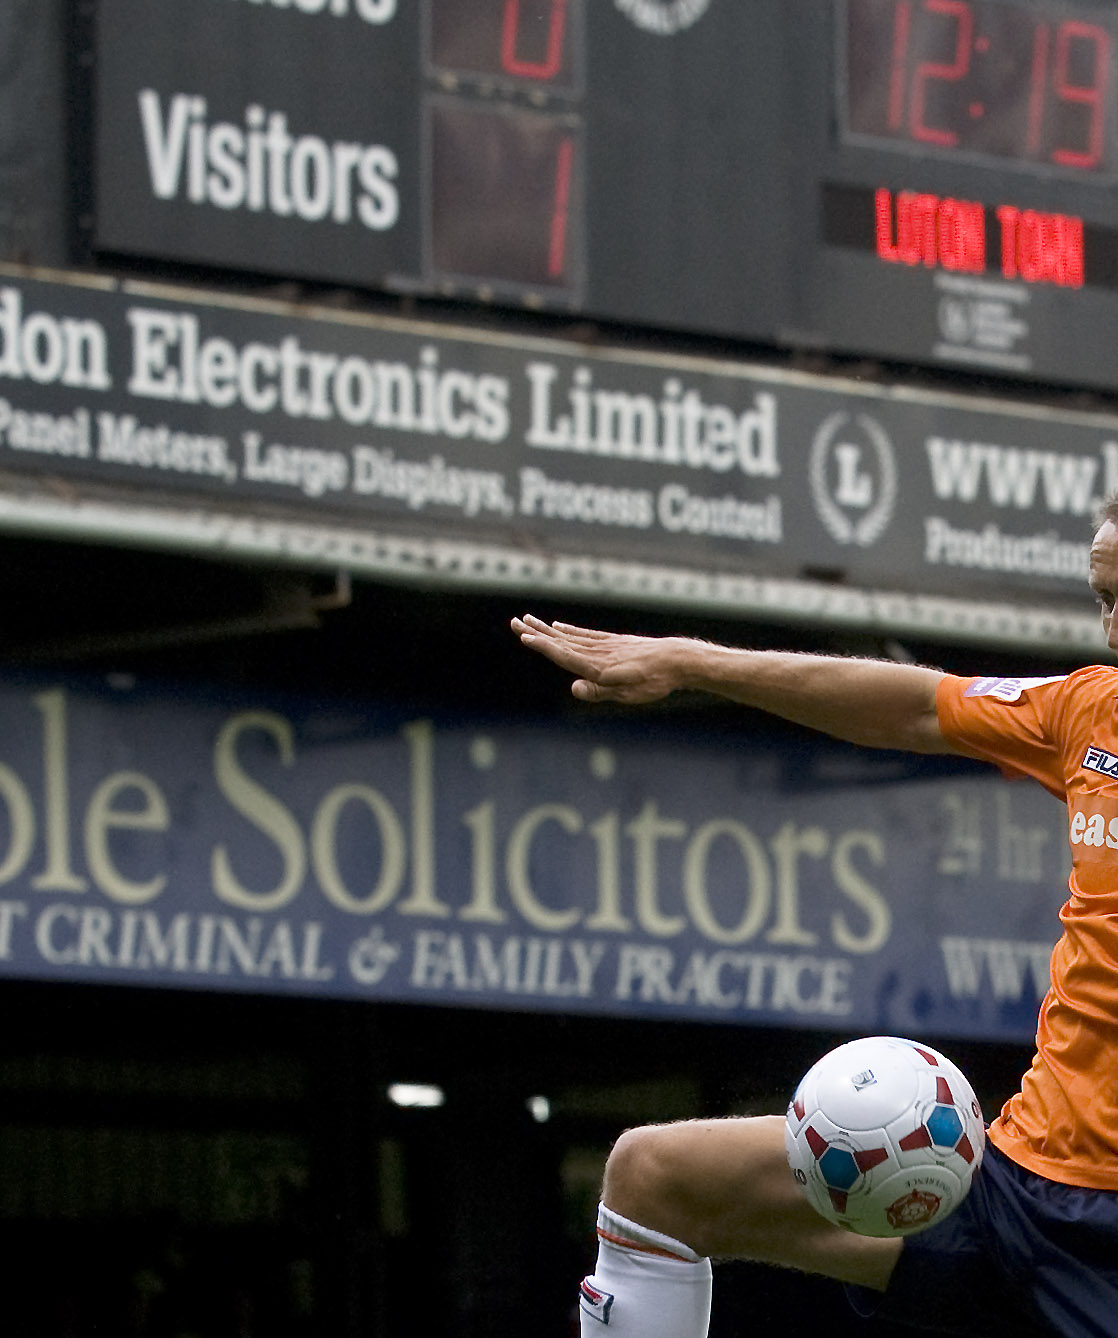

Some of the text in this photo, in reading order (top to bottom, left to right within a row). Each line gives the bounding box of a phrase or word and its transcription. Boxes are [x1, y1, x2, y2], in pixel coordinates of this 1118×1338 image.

[138, 88, 400, 232] Visitors
[126, 308, 510, 443] Electronics
[525, 360, 780, 478] Limited
[97, 411, 238, 484] Meters,
[241, 430, 350, 499] Large
[518, 466, 655, 530] Process
[657, 481, 784, 544] Control
[211, 709, 893, 955] Solicitors
[35, 902, 333, 984] CRIMINAL
[349, 924, 399, 986] &
[411, 930, 603, 1001] FAMILY
[617, 943, 854, 1014] PRACTICE
